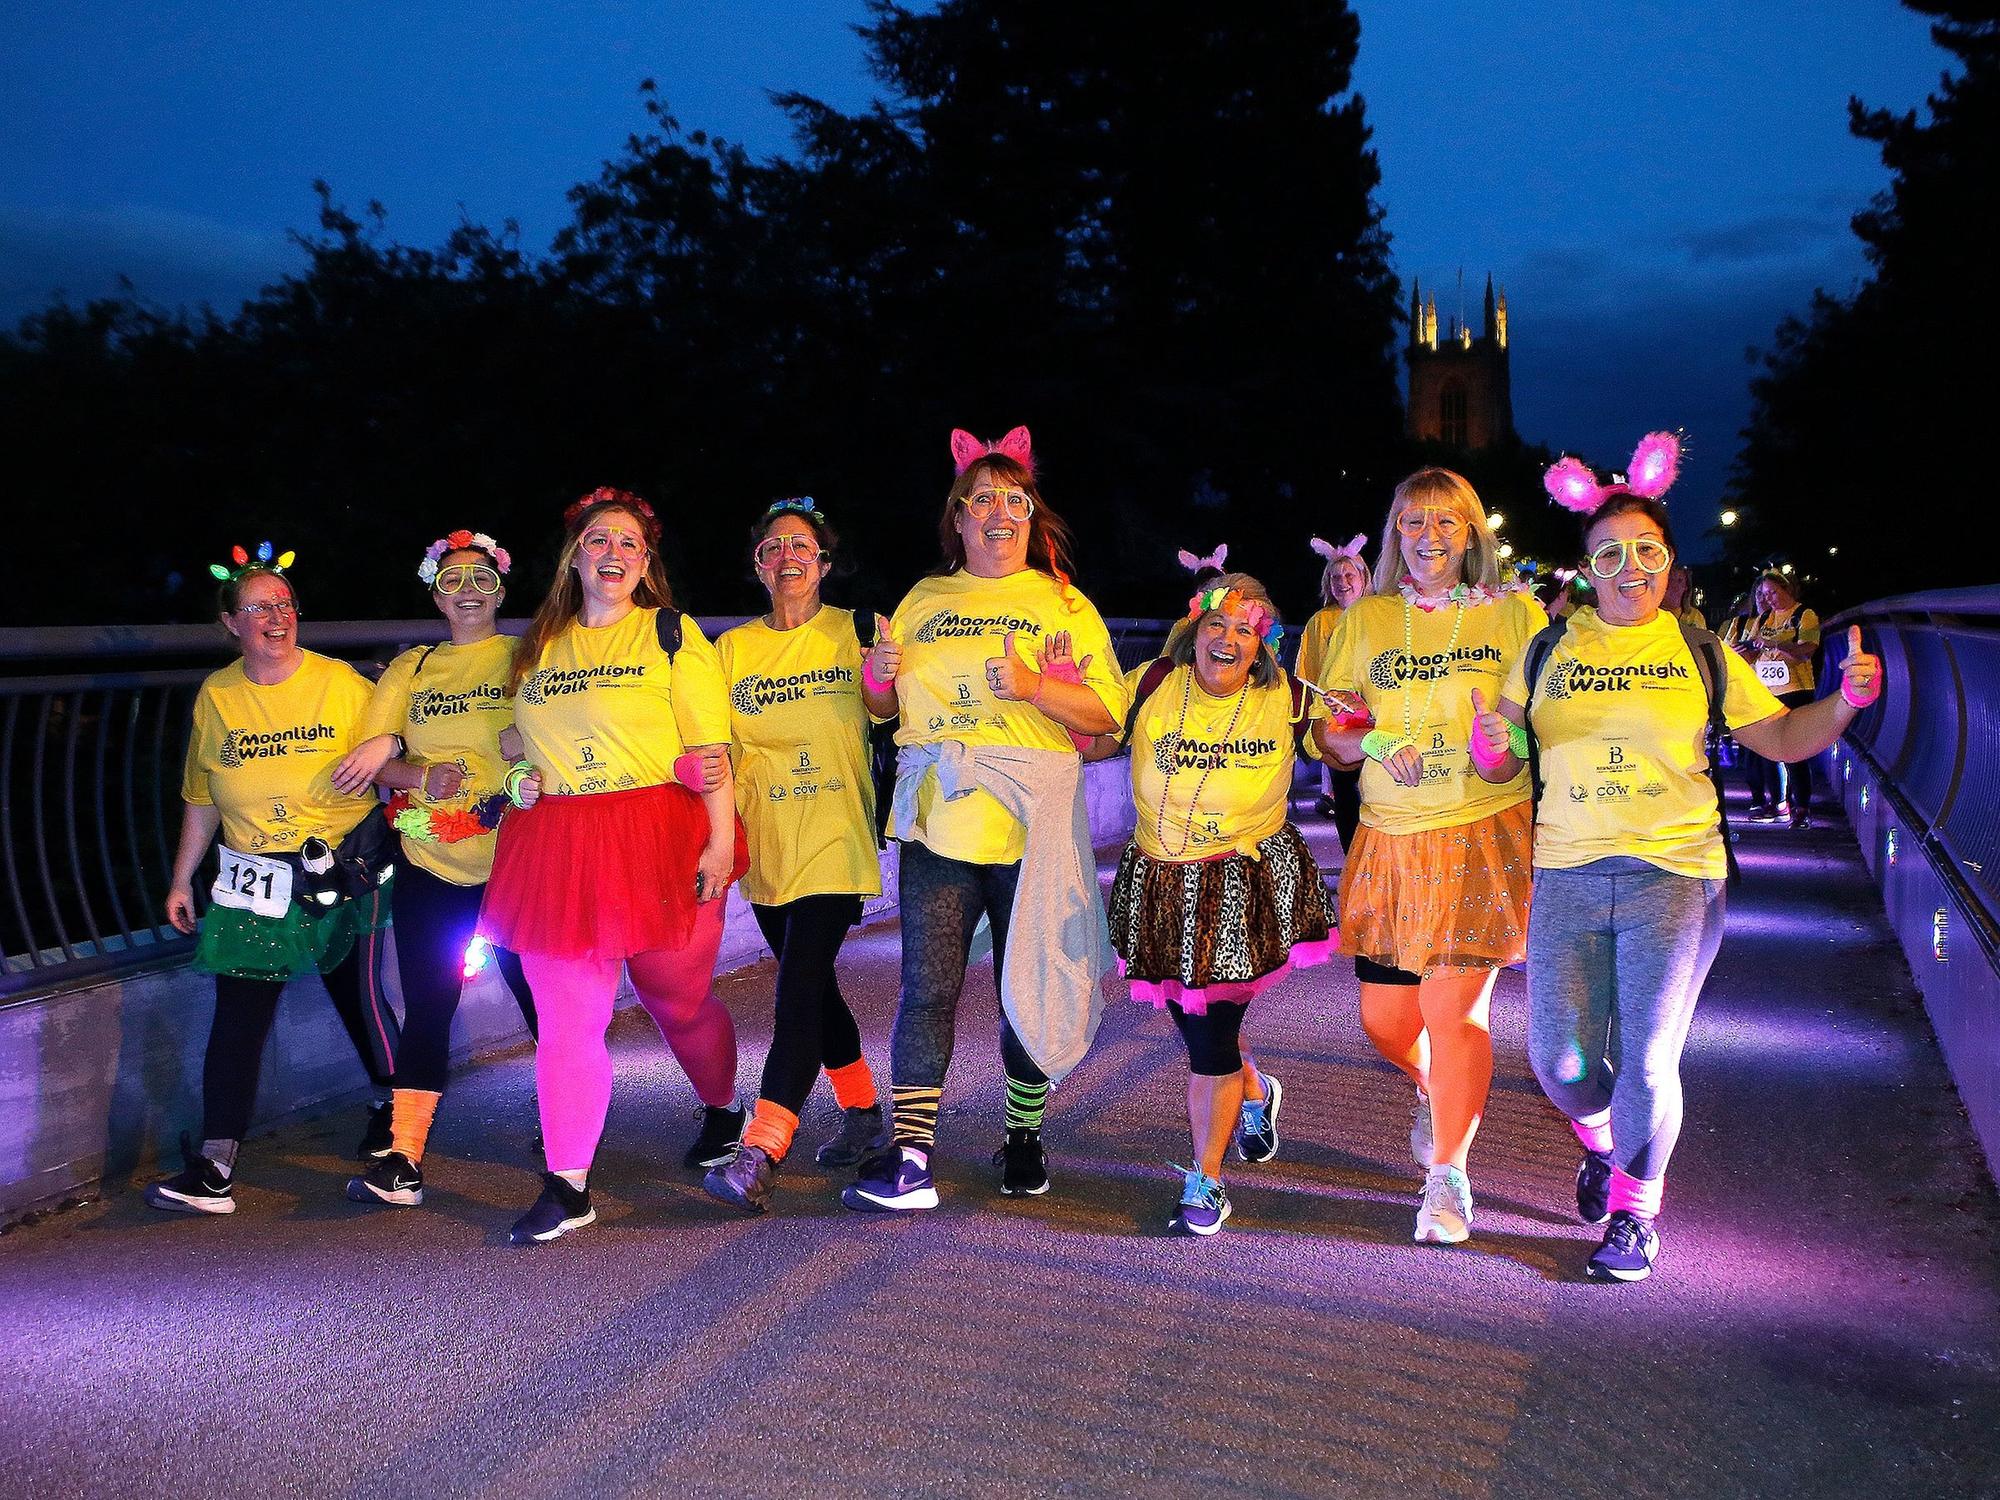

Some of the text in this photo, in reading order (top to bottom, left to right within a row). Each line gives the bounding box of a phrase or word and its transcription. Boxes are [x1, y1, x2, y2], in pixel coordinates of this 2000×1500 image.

[936, 626, 984, 638] Walk
[941, 614, 1041, 637] Moonlight
[1394, 645, 1501, 666] Moonlight
[547, 665, 646, 683] Moonlight
[754, 666, 853, 692] Moonlight
[1394, 666, 1449, 681] Walk
[1572, 662, 1689, 679] Moonlight
[1761, 666, 1785, 679] 236
[543, 679, 590, 697] Walk
[1569, 678, 1631, 692] Walk
[425, 683, 507, 705] Moonlig
[754, 688, 806, 707] Walk
[423, 701, 470, 717] Walk
[238, 723, 336, 747] Moonlight
[238, 743, 288, 760] Walk
[1176, 739, 1276, 756] Moonlight
[1175, 754, 1229, 770] Walk
[580, 779, 607, 792] COW
[793, 785, 818, 795] COW
[1597, 785, 1630, 797] COW
[273, 829, 299, 842] COW
[230, 863, 274, 900] 121
